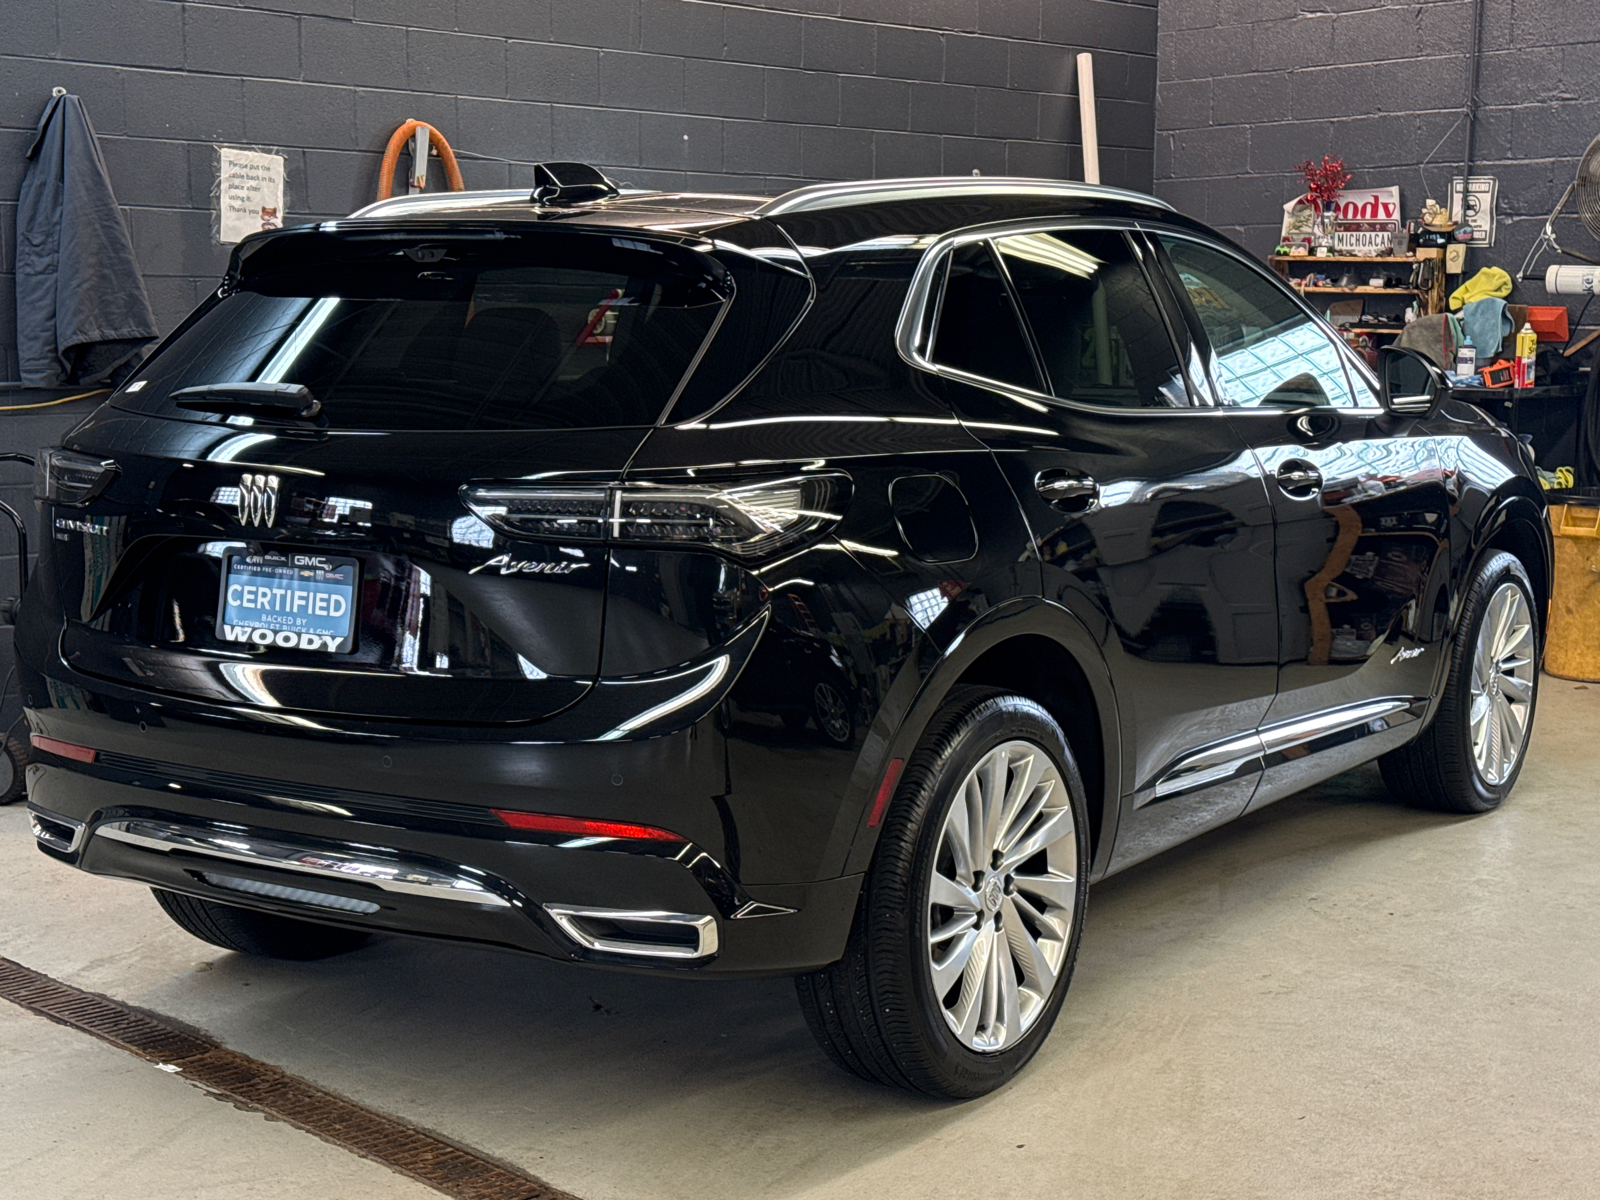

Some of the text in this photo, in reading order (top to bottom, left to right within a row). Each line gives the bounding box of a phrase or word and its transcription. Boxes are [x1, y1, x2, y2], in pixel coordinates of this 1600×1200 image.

[229, 161, 248, 169] Please
[229, 172, 245, 180] cable
[229, 183, 245, 191] place
[228, 194, 245, 203] using
[229, 206, 247, 214] Thank
[1337, 233, 1393, 248] MICHOACAN
[294, 556, 327, 567] GMC
[468, 553, 591, 575] Avenir
[233, 564, 294, 575] CERTIFIED PRE-OWNED
[227, 584, 346, 617] CERTIFIED
[261, 614, 307, 627] BACKED BY
[223, 625, 344, 653] WOODY
